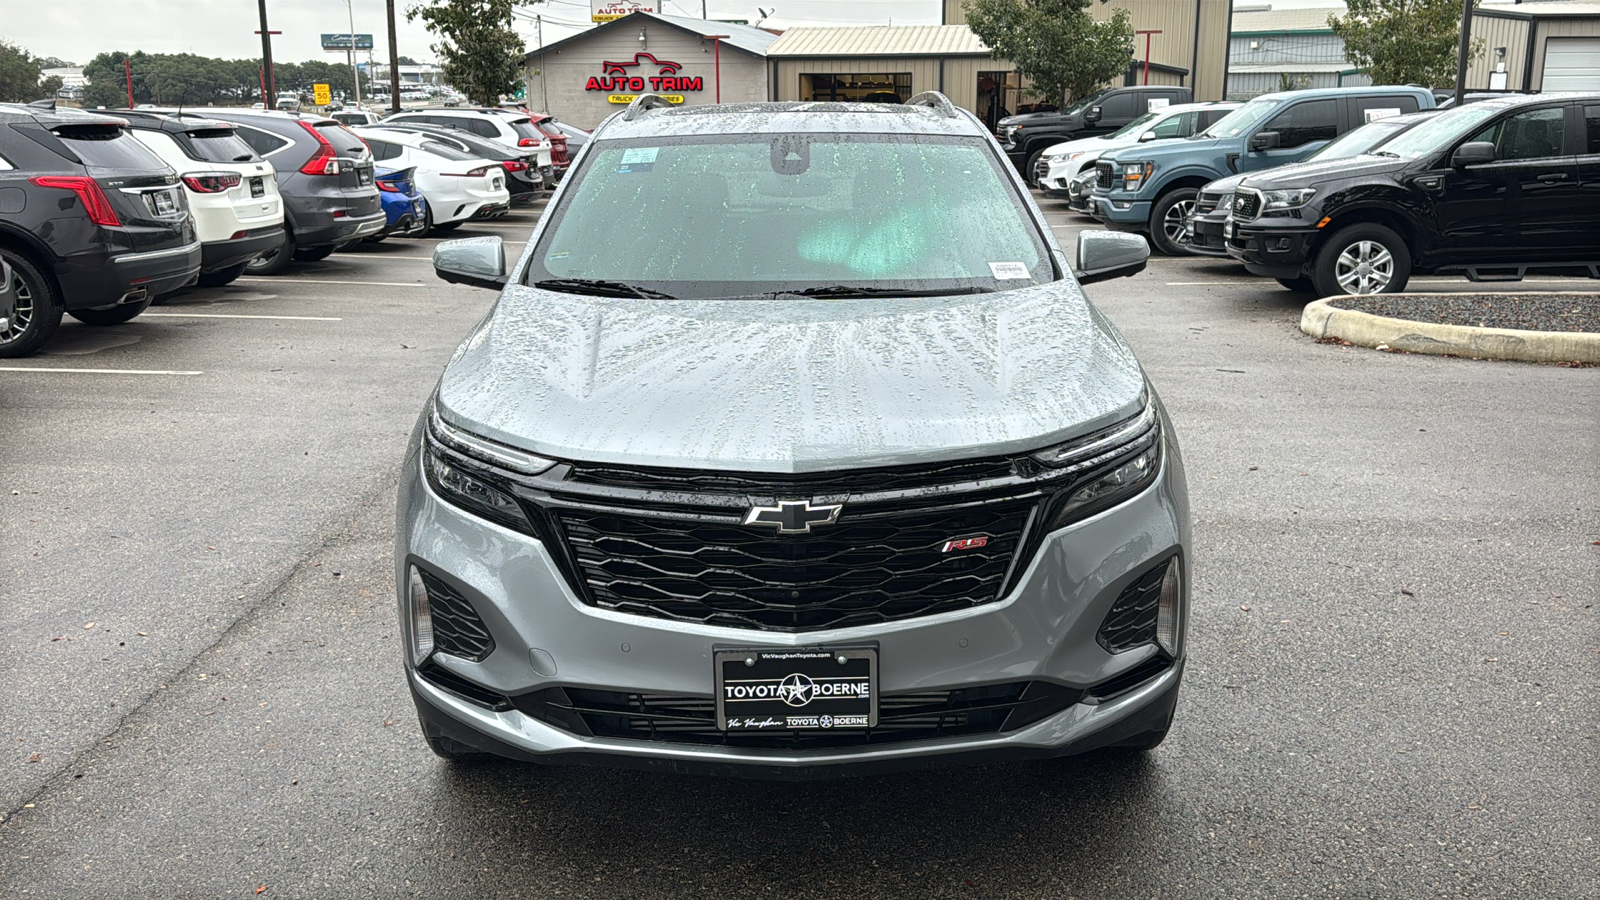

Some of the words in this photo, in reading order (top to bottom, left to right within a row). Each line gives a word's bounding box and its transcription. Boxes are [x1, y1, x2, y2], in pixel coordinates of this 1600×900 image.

[585, 76, 645, 91] AUTO
[648, 76, 703, 91] TRIM
[317, 92, 328, 100] 50
[941, 536, 989, 552] RS
[725, 685, 787, 698] TOYOTA
[812, 683, 870, 696] BOERNE
[786, 718, 819, 726] TOYOTA
[833, 717, 868, 725] BOERNE
